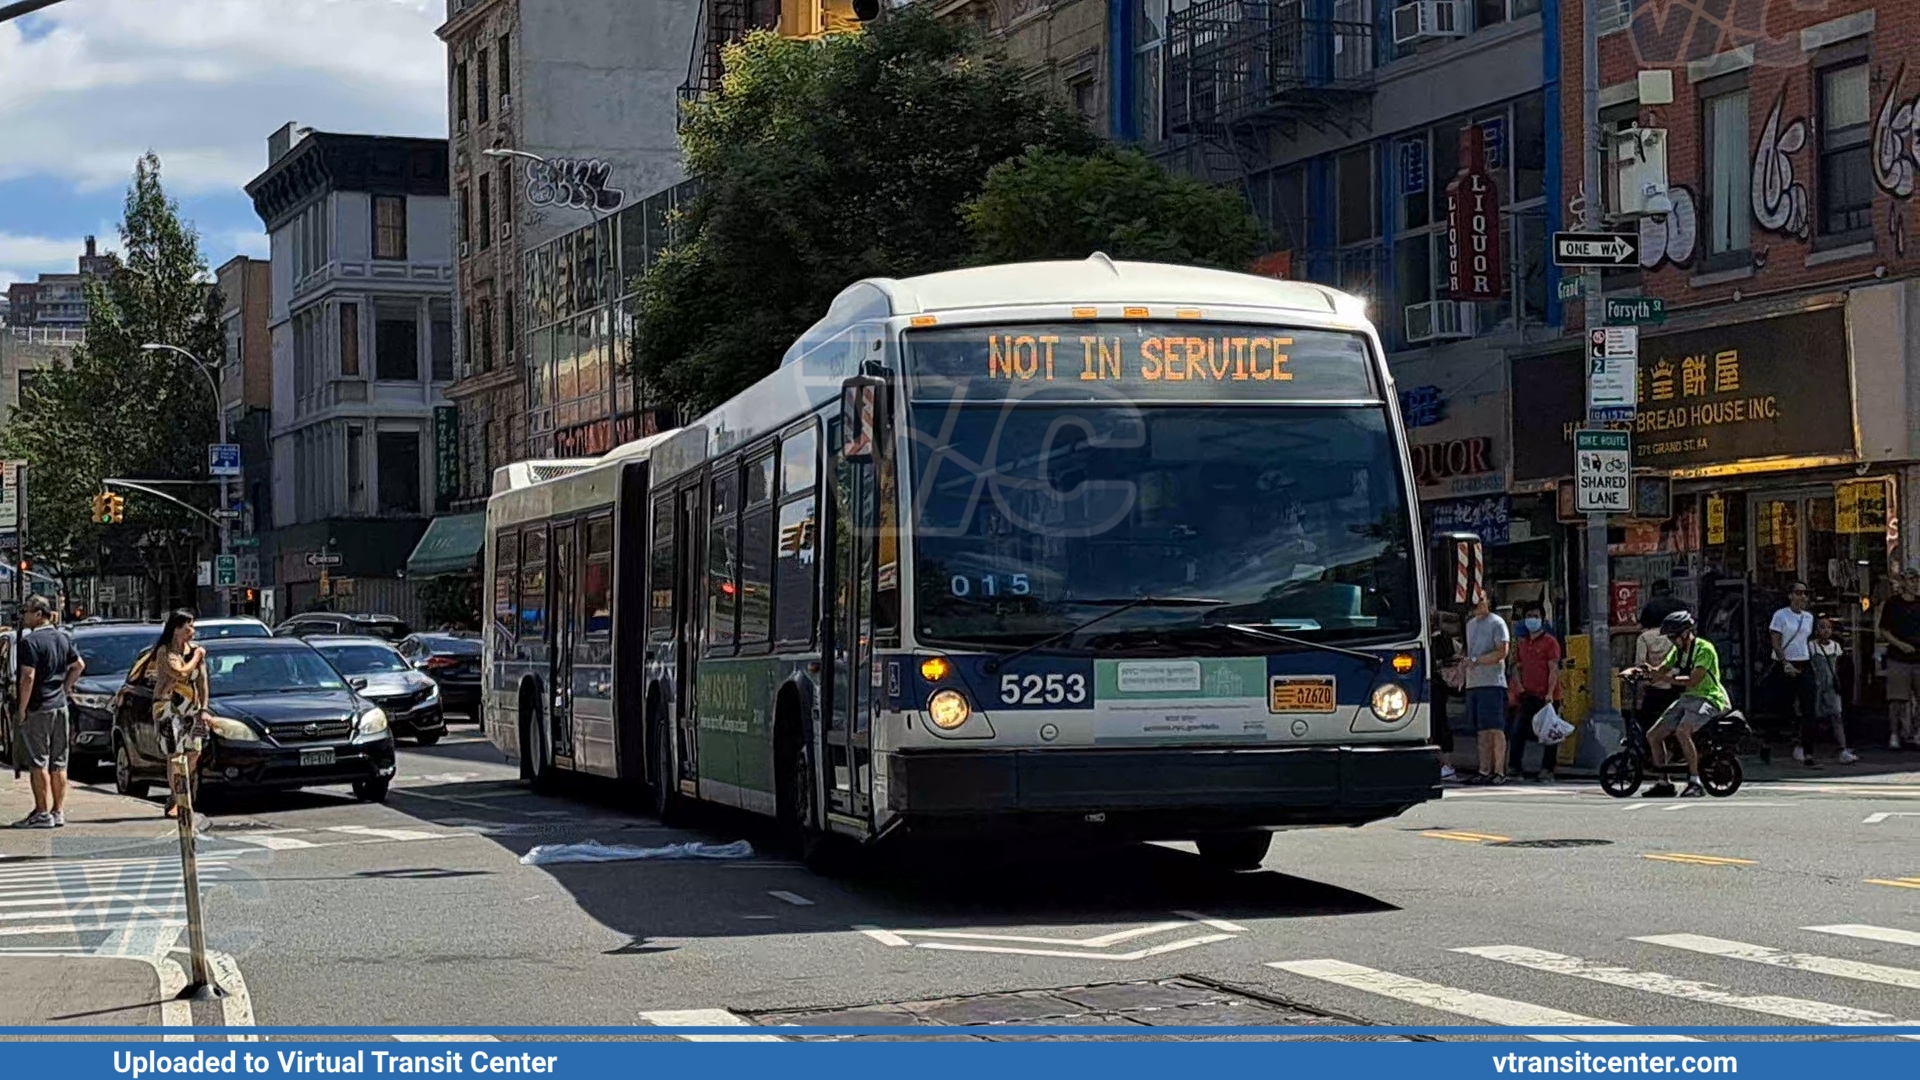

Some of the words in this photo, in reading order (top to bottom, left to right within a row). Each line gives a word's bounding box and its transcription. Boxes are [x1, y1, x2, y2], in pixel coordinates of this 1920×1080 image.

[1448, 196, 1459, 291] LIQUOR
[1471, 175, 1490, 293] LIQUOR
[1566, 243, 1590, 255] ONE
[1601, 243, 1626, 255] WAY
[1557, 278, 1579, 300] Grand
[1608, 301, 1649, 321] Forsyth
[988, 335, 1060, 380] NOT
[1079, 336, 1122, 380] IN
[1141, 336, 1293, 381] SERVICE
[1637, 408, 1686, 433] BREAD
[1691, 400, 1744, 426] HOUSE
[1749, 396, 1781, 419] INC.
[1580, 435, 1598, 446] BIKE
[1601, 435, 1626, 446] ROUTE
[1652, 440, 1681, 454] GRAND
[1581, 476, 1626, 488] SHARED
[1589, 492, 1619, 504] LANE
[1001, 673, 1086, 704] 5253
